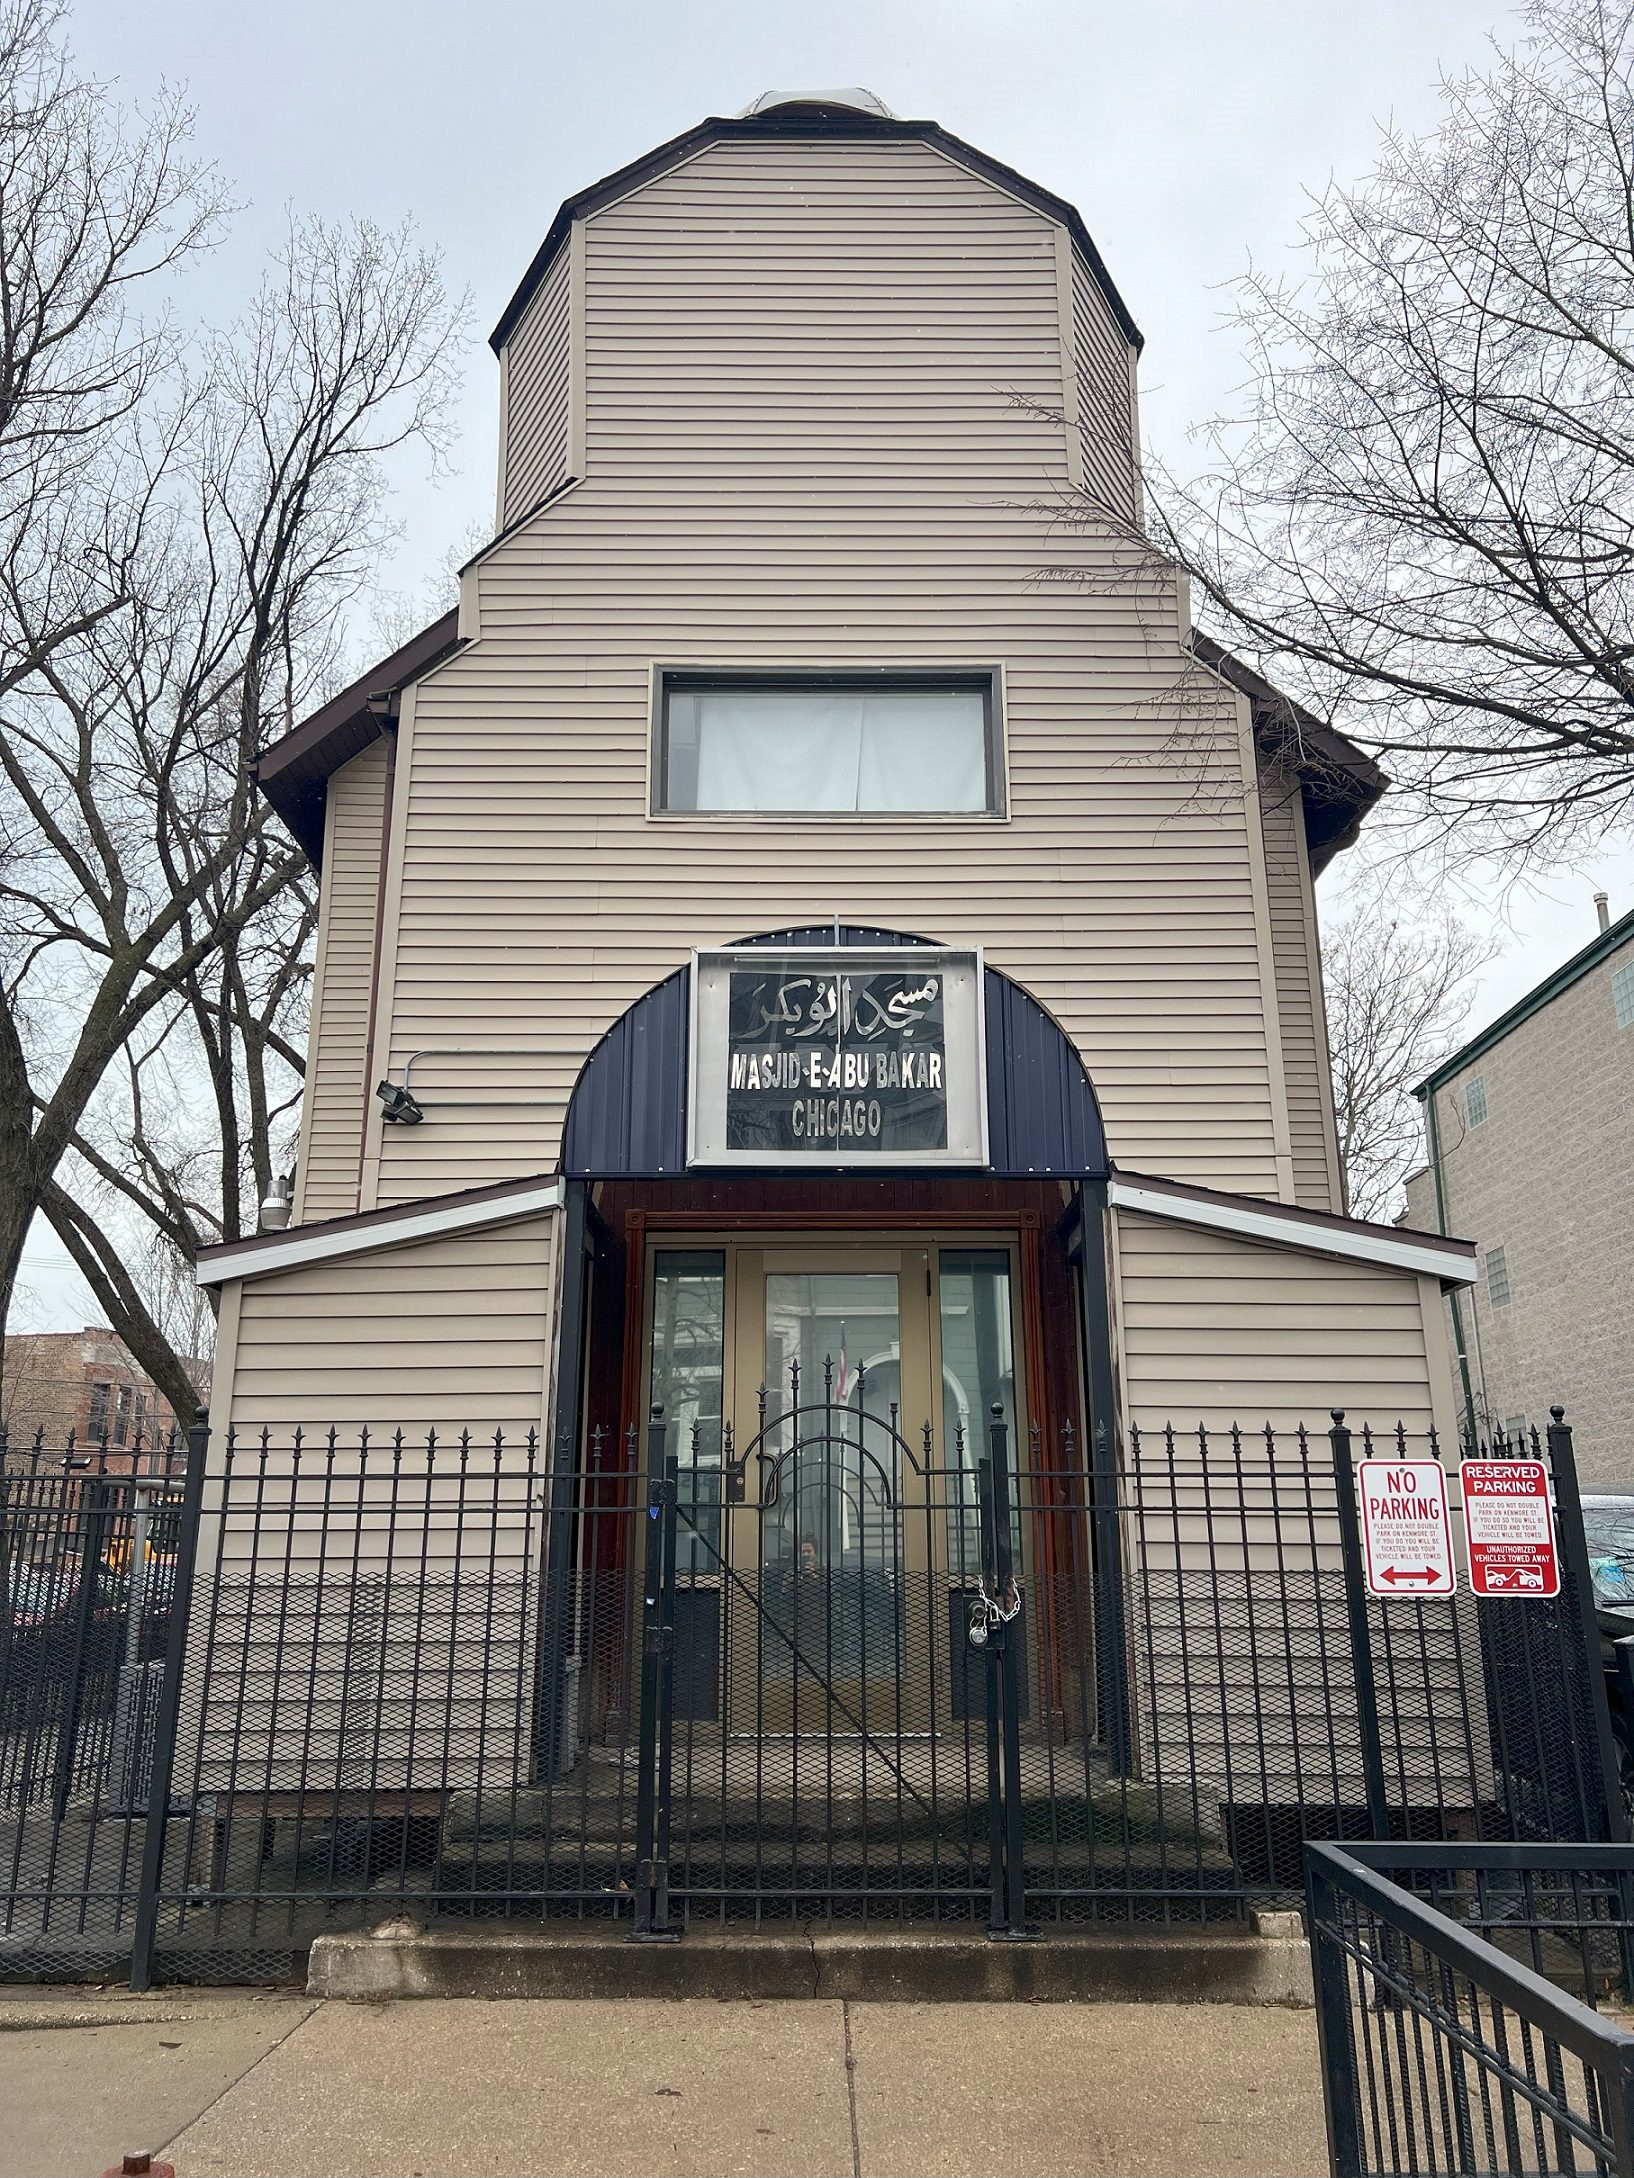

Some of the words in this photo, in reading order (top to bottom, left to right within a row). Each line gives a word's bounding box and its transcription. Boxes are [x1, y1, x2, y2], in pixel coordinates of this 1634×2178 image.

[876, 1051, 942, 1089] BAKAR
[792, 1099, 881, 1137] CHICAGO
[1466, 1466, 1540, 1478] RESERVED
[1387, 1471, 1416, 1493] NO
[1474, 1481, 1536, 1493] PARKING
[1370, 1498, 1440, 1520] PARKING
[1486, 1545, 1536, 1553] UNAUTHORIZED
[1475, 1554, 1506, 1562] VEHICLES
[1507, 1554, 1529, 1562] TOWED
[1532, 1554, 1550, 1562] AWAY
